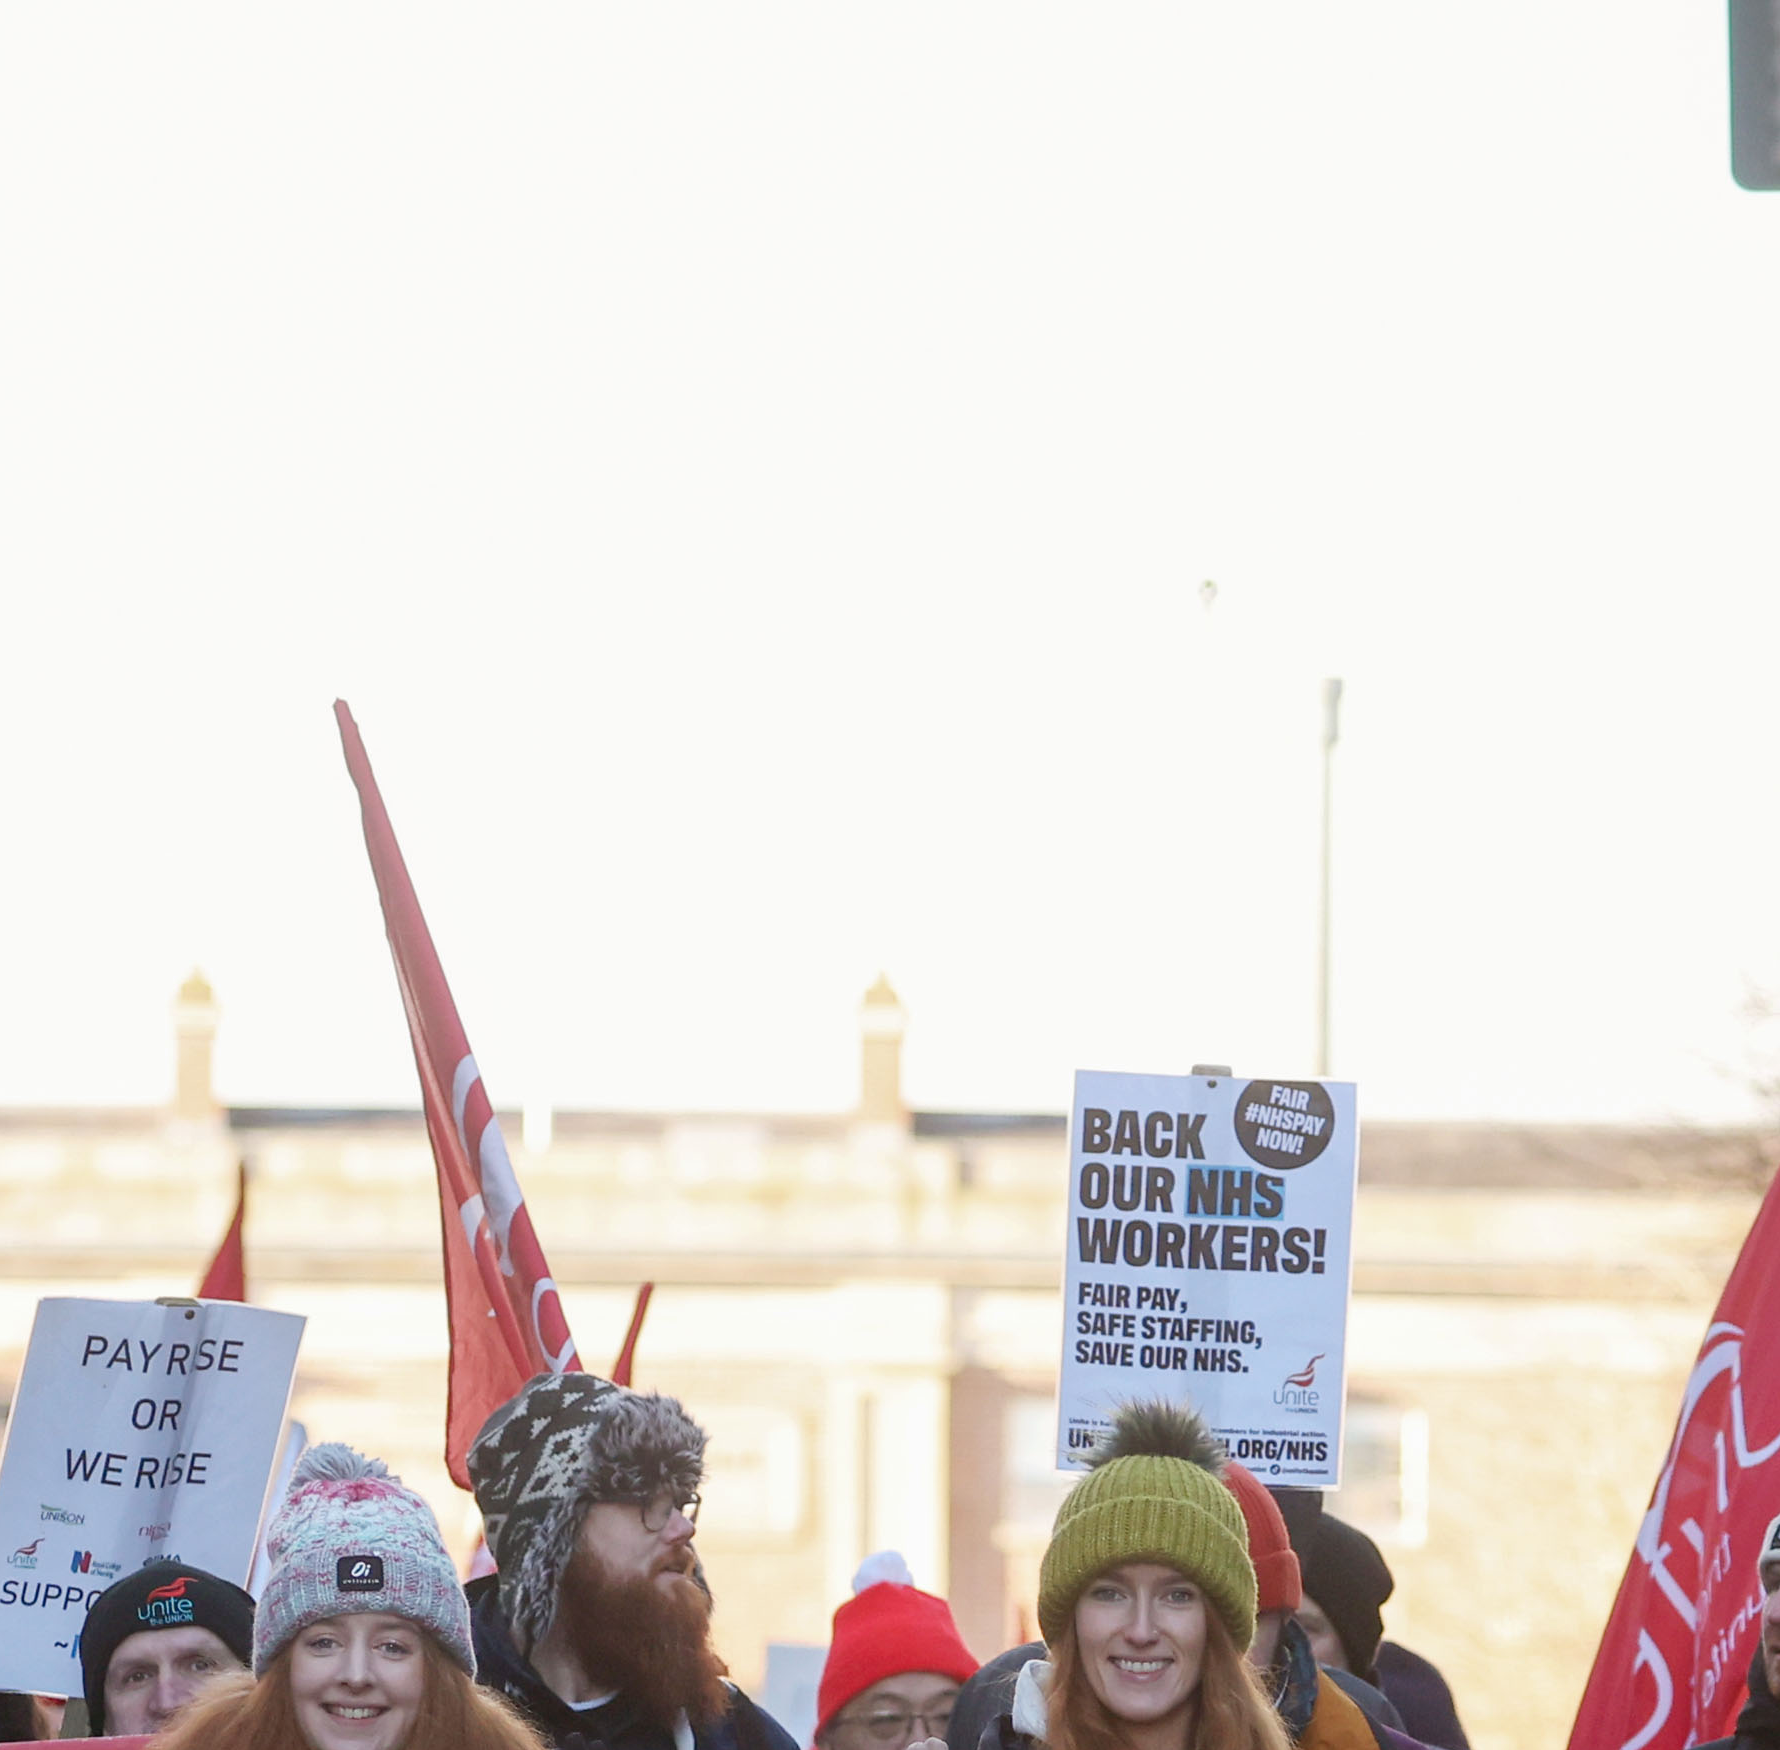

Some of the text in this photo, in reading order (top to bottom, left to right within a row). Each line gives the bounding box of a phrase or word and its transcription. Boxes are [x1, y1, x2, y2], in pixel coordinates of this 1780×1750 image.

[1269, 1084, 1310, 1111] FAIR
[1082, 1108, 1207, 1160] BACK
[1244, 1105, 1325, 1137] #NHSPAY
[1255, 1127, 1305, 1155] NOW!
[1079, 1162, 1285, 1218] OUR NHS
[1076, 1217, 1327, 1274] WORKERS!
[1078, 1282, 1188, 1314] FAIR PAY,
[1077, 1311, 1262, 1349] SAFE STAFFING,
[81, 1335, 163, 1374] PAY
[1075, 1339, 1250, 1373] SAVE OUR NHS.
[1272, 1389, 1319, 1406] unite
[131, 1398, 182, 1432] OR
[65, 1448, 212, 1490] WE RISE
[40, 1511, 85, 1525] UNISON
[351, 1561, 372, 1578] Oi
[0, 1579, 103, 1612] SUPPO
[137, 1595, 193, 1621] unite
